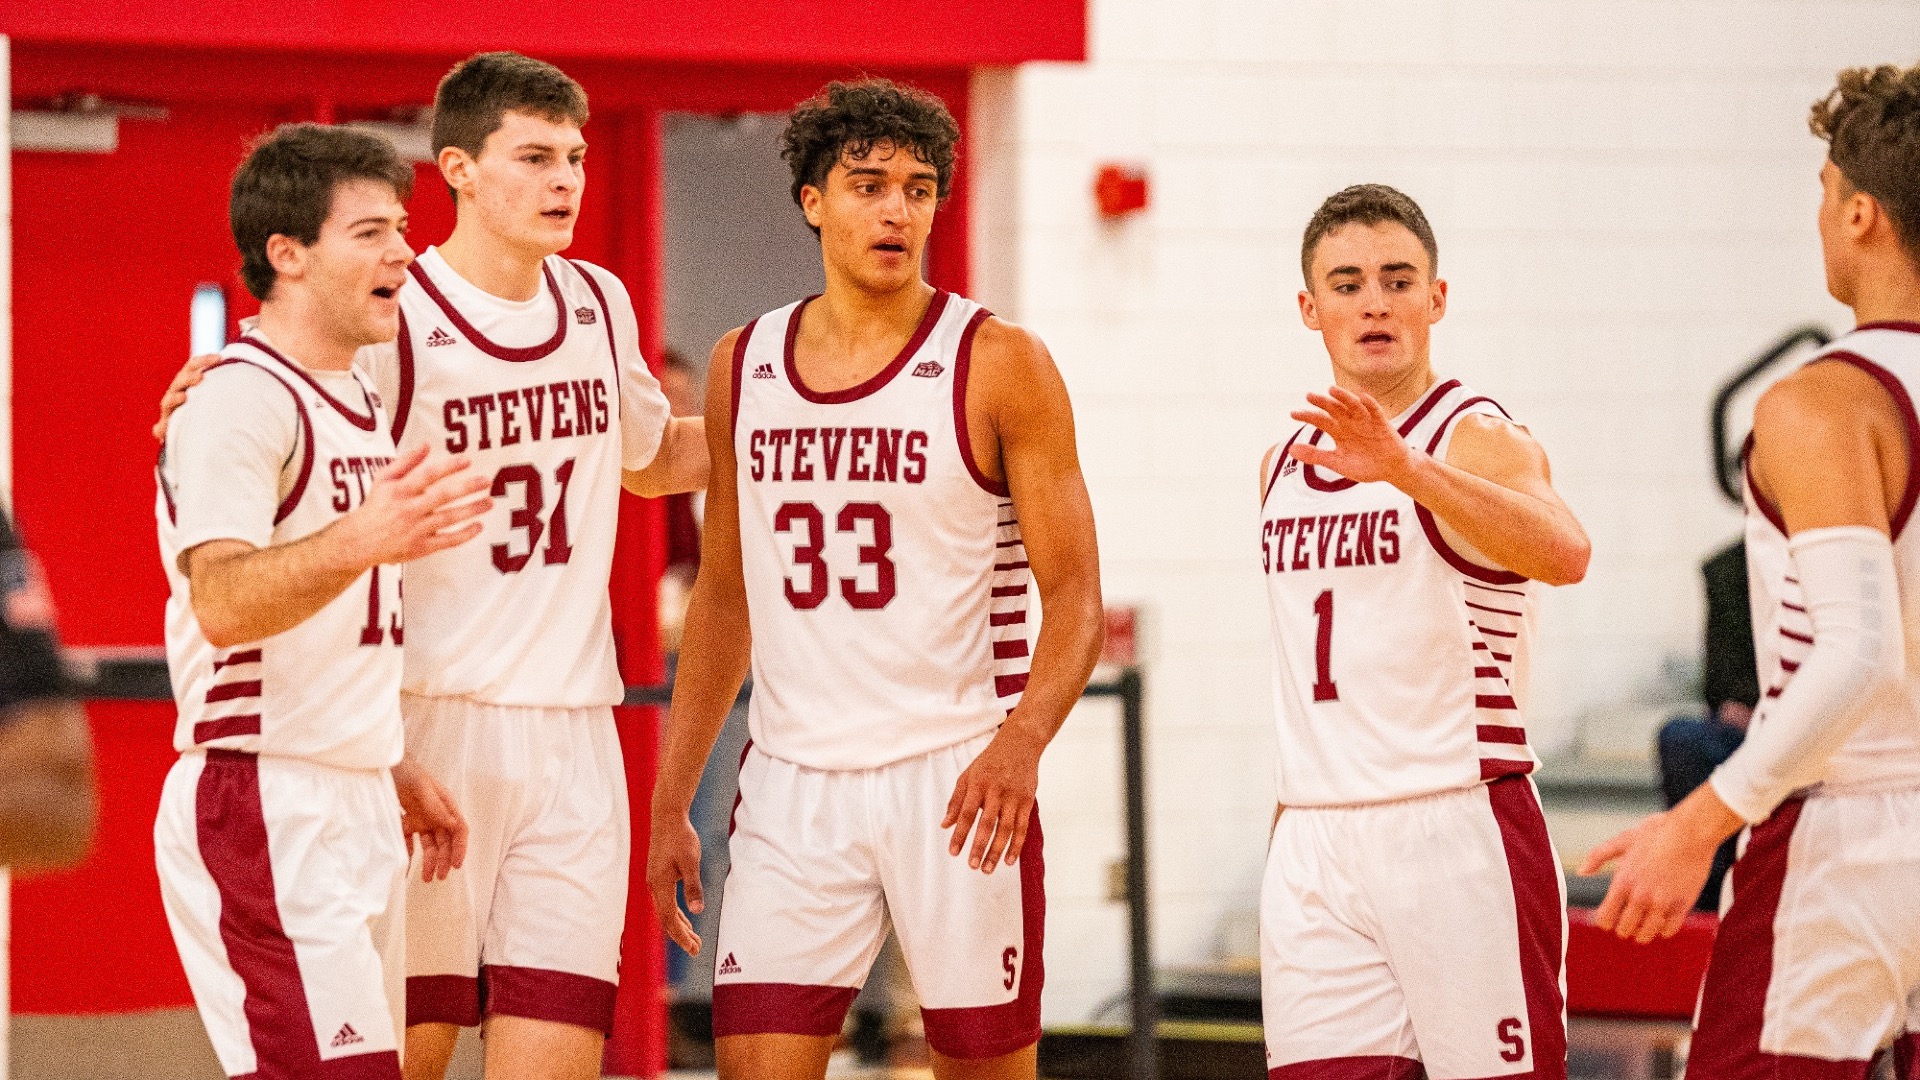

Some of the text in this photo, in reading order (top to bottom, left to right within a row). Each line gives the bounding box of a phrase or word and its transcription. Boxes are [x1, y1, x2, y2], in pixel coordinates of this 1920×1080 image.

[443, 378, 609, 455] STEVENS
[750, 427, 928, 485] STEVENS
[490, 457, 577, 576] 31
[1261, 508, 1401, 575] STEVENS
[773, 500, 898, 612] 33
[1313, 588, 1341, 703] 1
[1002, 946, 1018, 991] S
[1497, 1017, 1525, 1063] S
